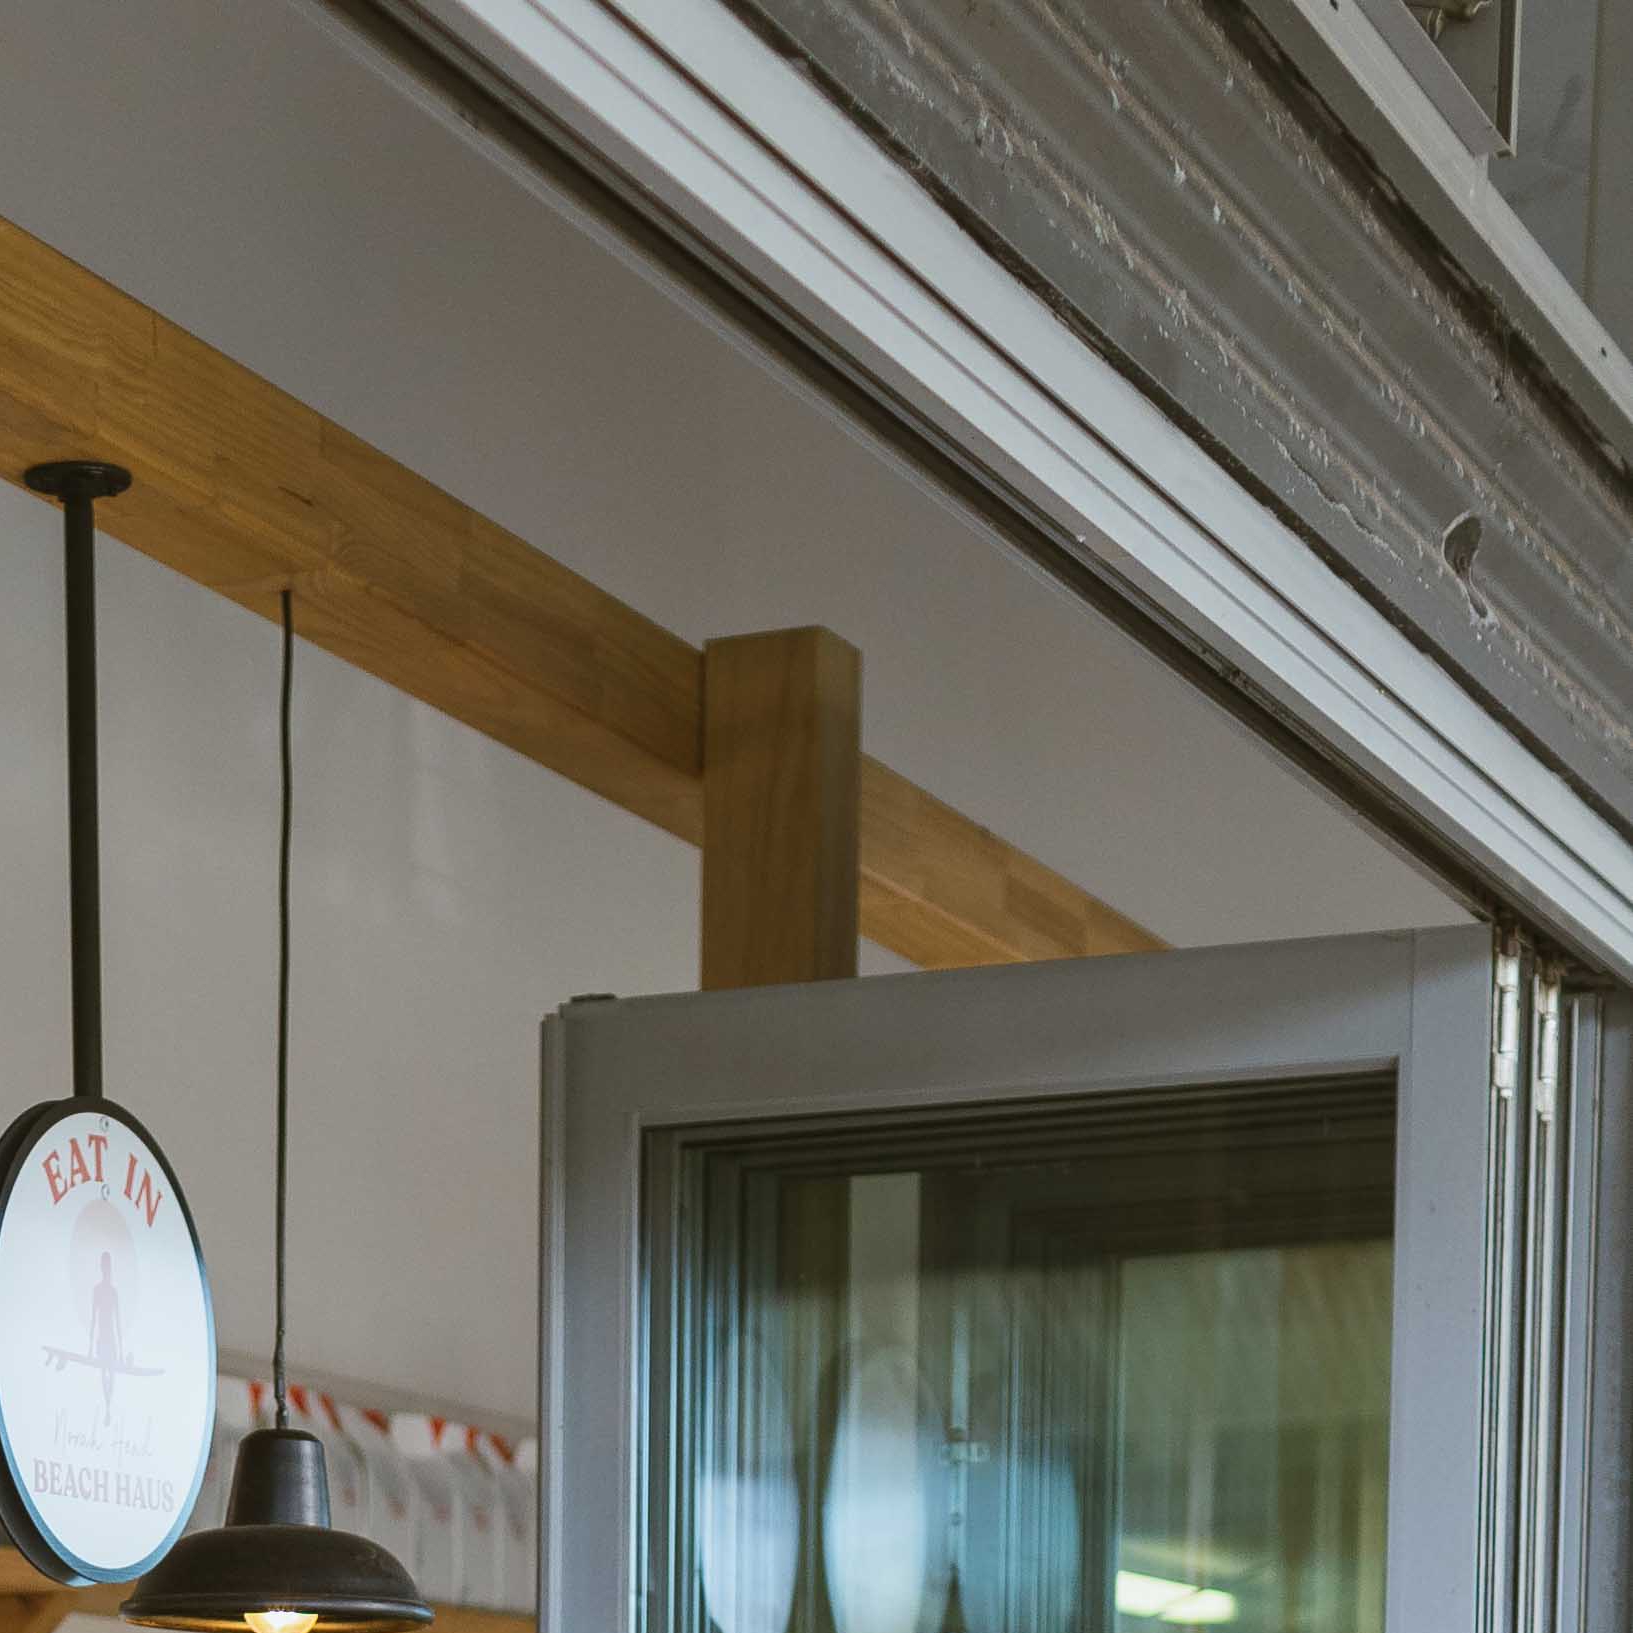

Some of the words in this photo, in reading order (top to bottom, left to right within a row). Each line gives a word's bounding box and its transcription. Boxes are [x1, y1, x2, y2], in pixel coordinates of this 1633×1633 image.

[41, 1134, 108, 1206] EAT
[123, 1151, 164, 1228] IN
[32, 1457, 109, 1504] BEACH
[115, 1472, 175, 1513] HAUS
